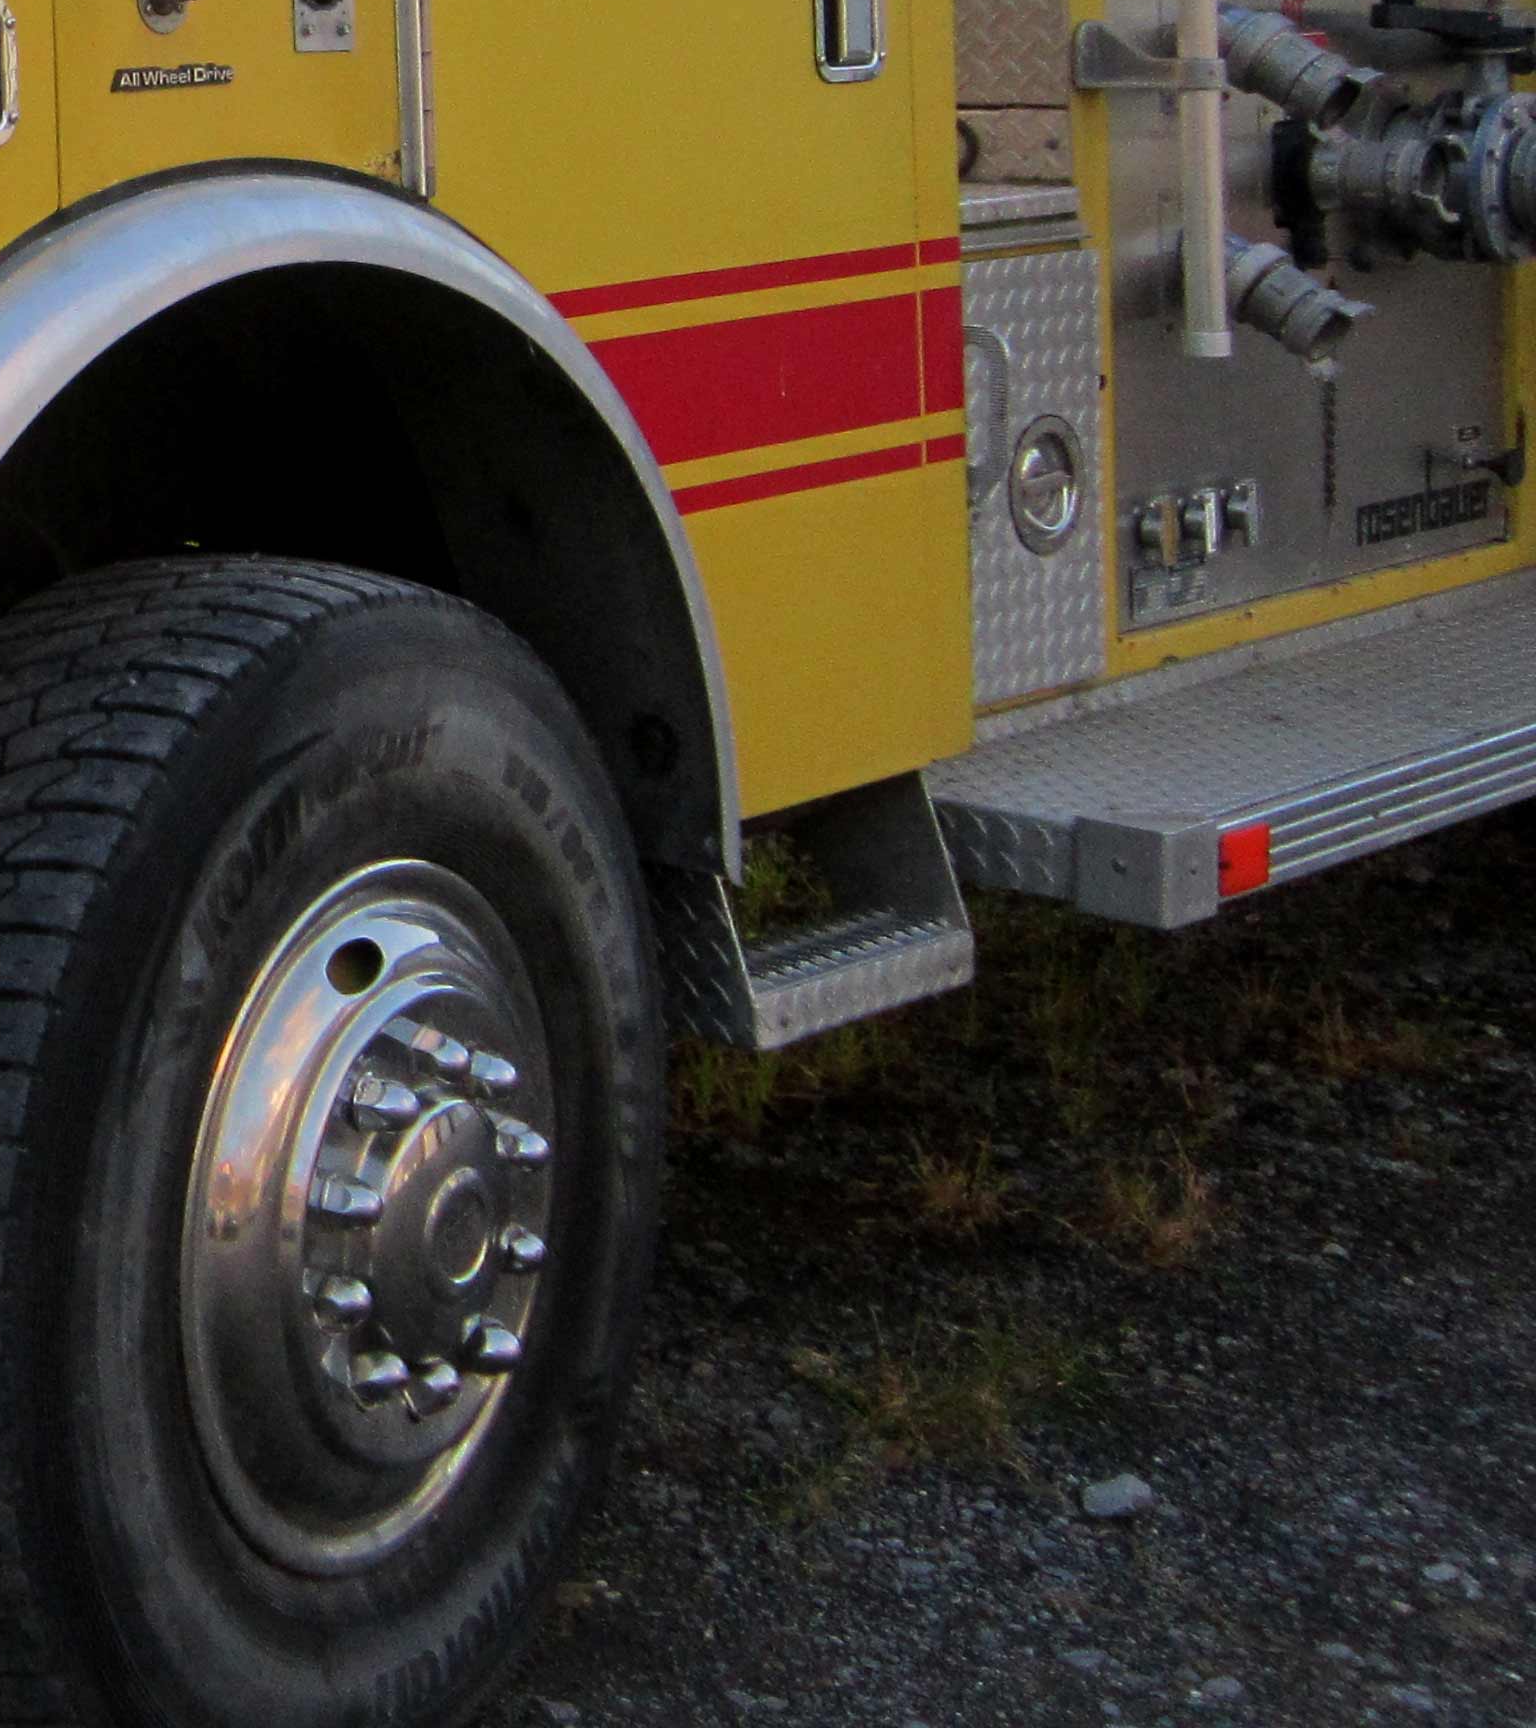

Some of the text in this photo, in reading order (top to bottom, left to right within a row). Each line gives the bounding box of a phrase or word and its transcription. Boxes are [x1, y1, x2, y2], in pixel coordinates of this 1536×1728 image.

[119, 66, 234, 88] All Wheel Drive
[1355, 448, 1491, 547] rosenbauer
